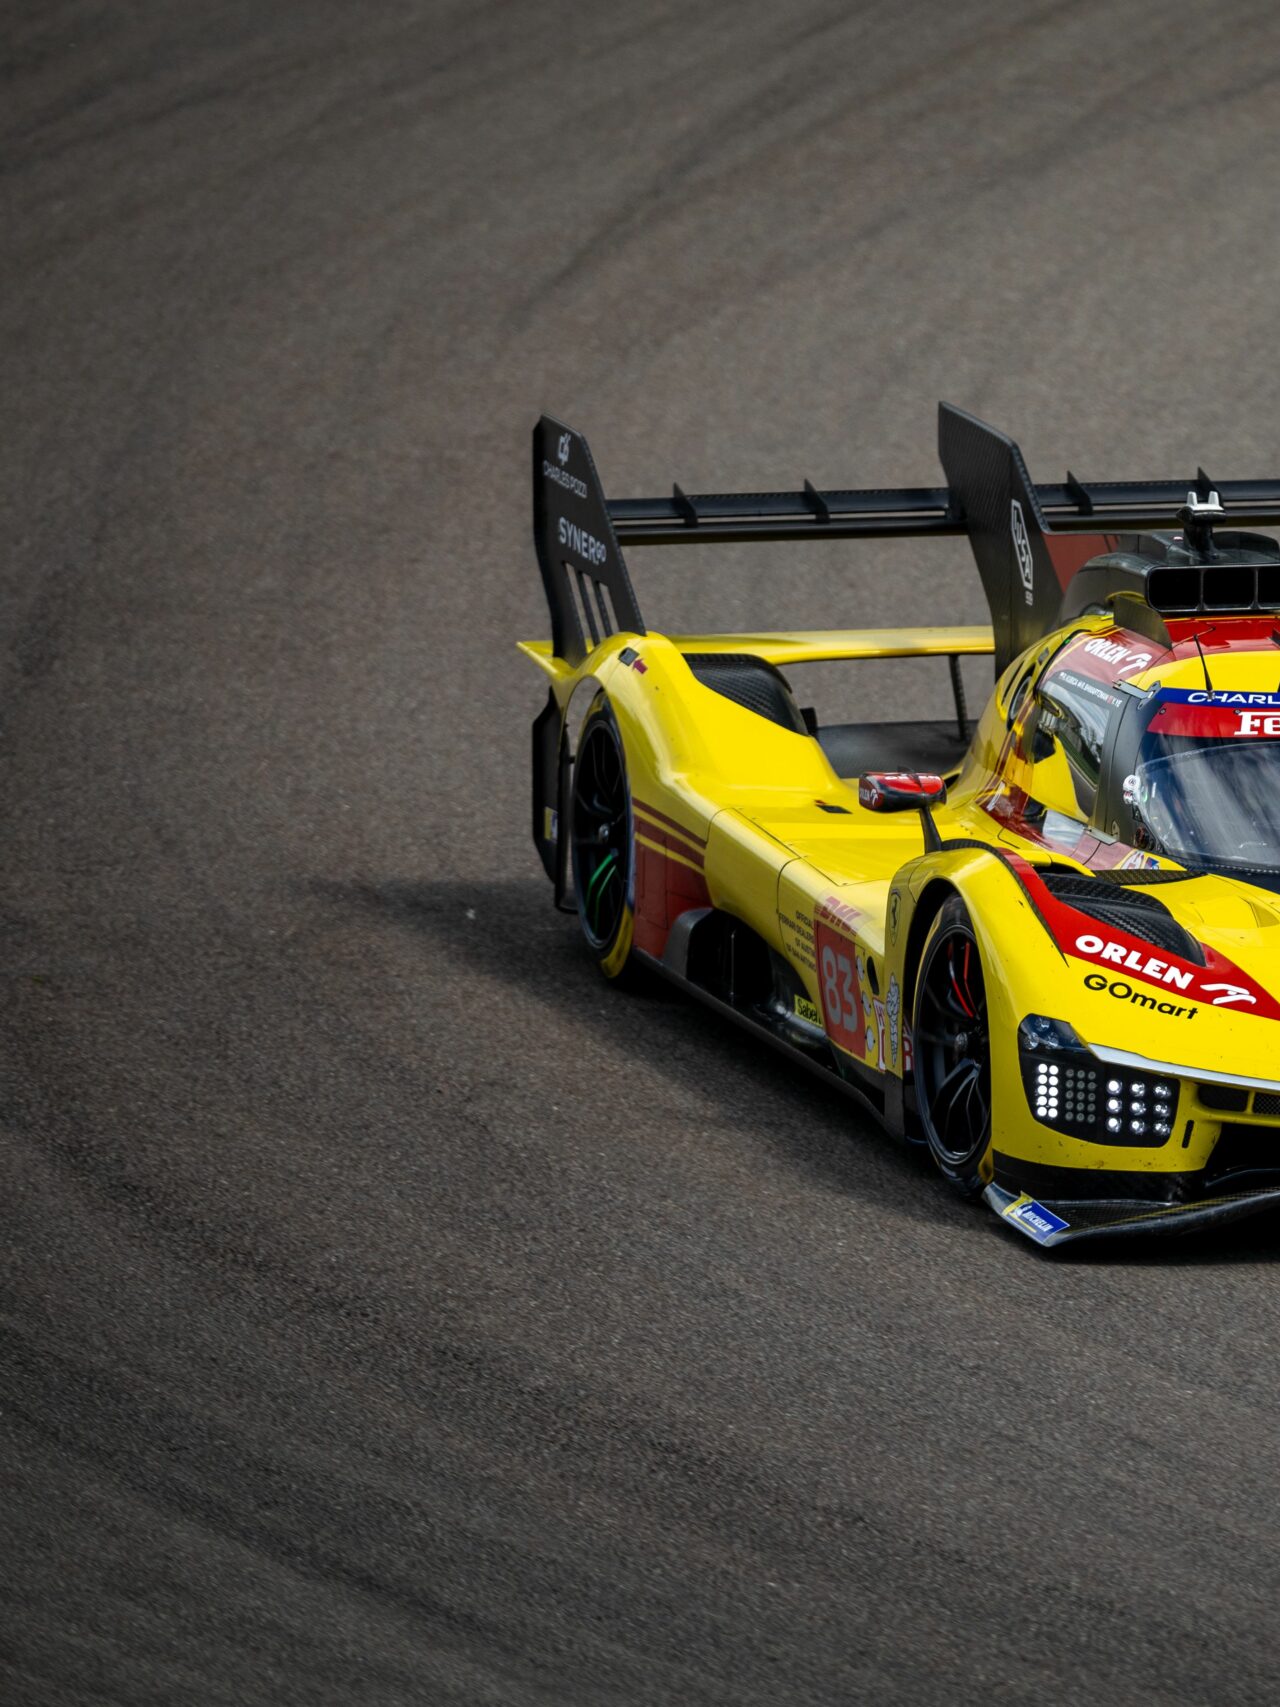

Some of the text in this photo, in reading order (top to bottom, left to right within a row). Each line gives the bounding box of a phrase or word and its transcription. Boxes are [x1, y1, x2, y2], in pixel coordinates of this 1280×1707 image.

[559, 516, 607, 565] SYNERGO
[1084, 638, 1132, 665] ORLEN
[1075, 935, 1194, 990] ORLEN
[823, 946, 857, 1032] 83
[1084, 974, 1199, 1020] GOmart
